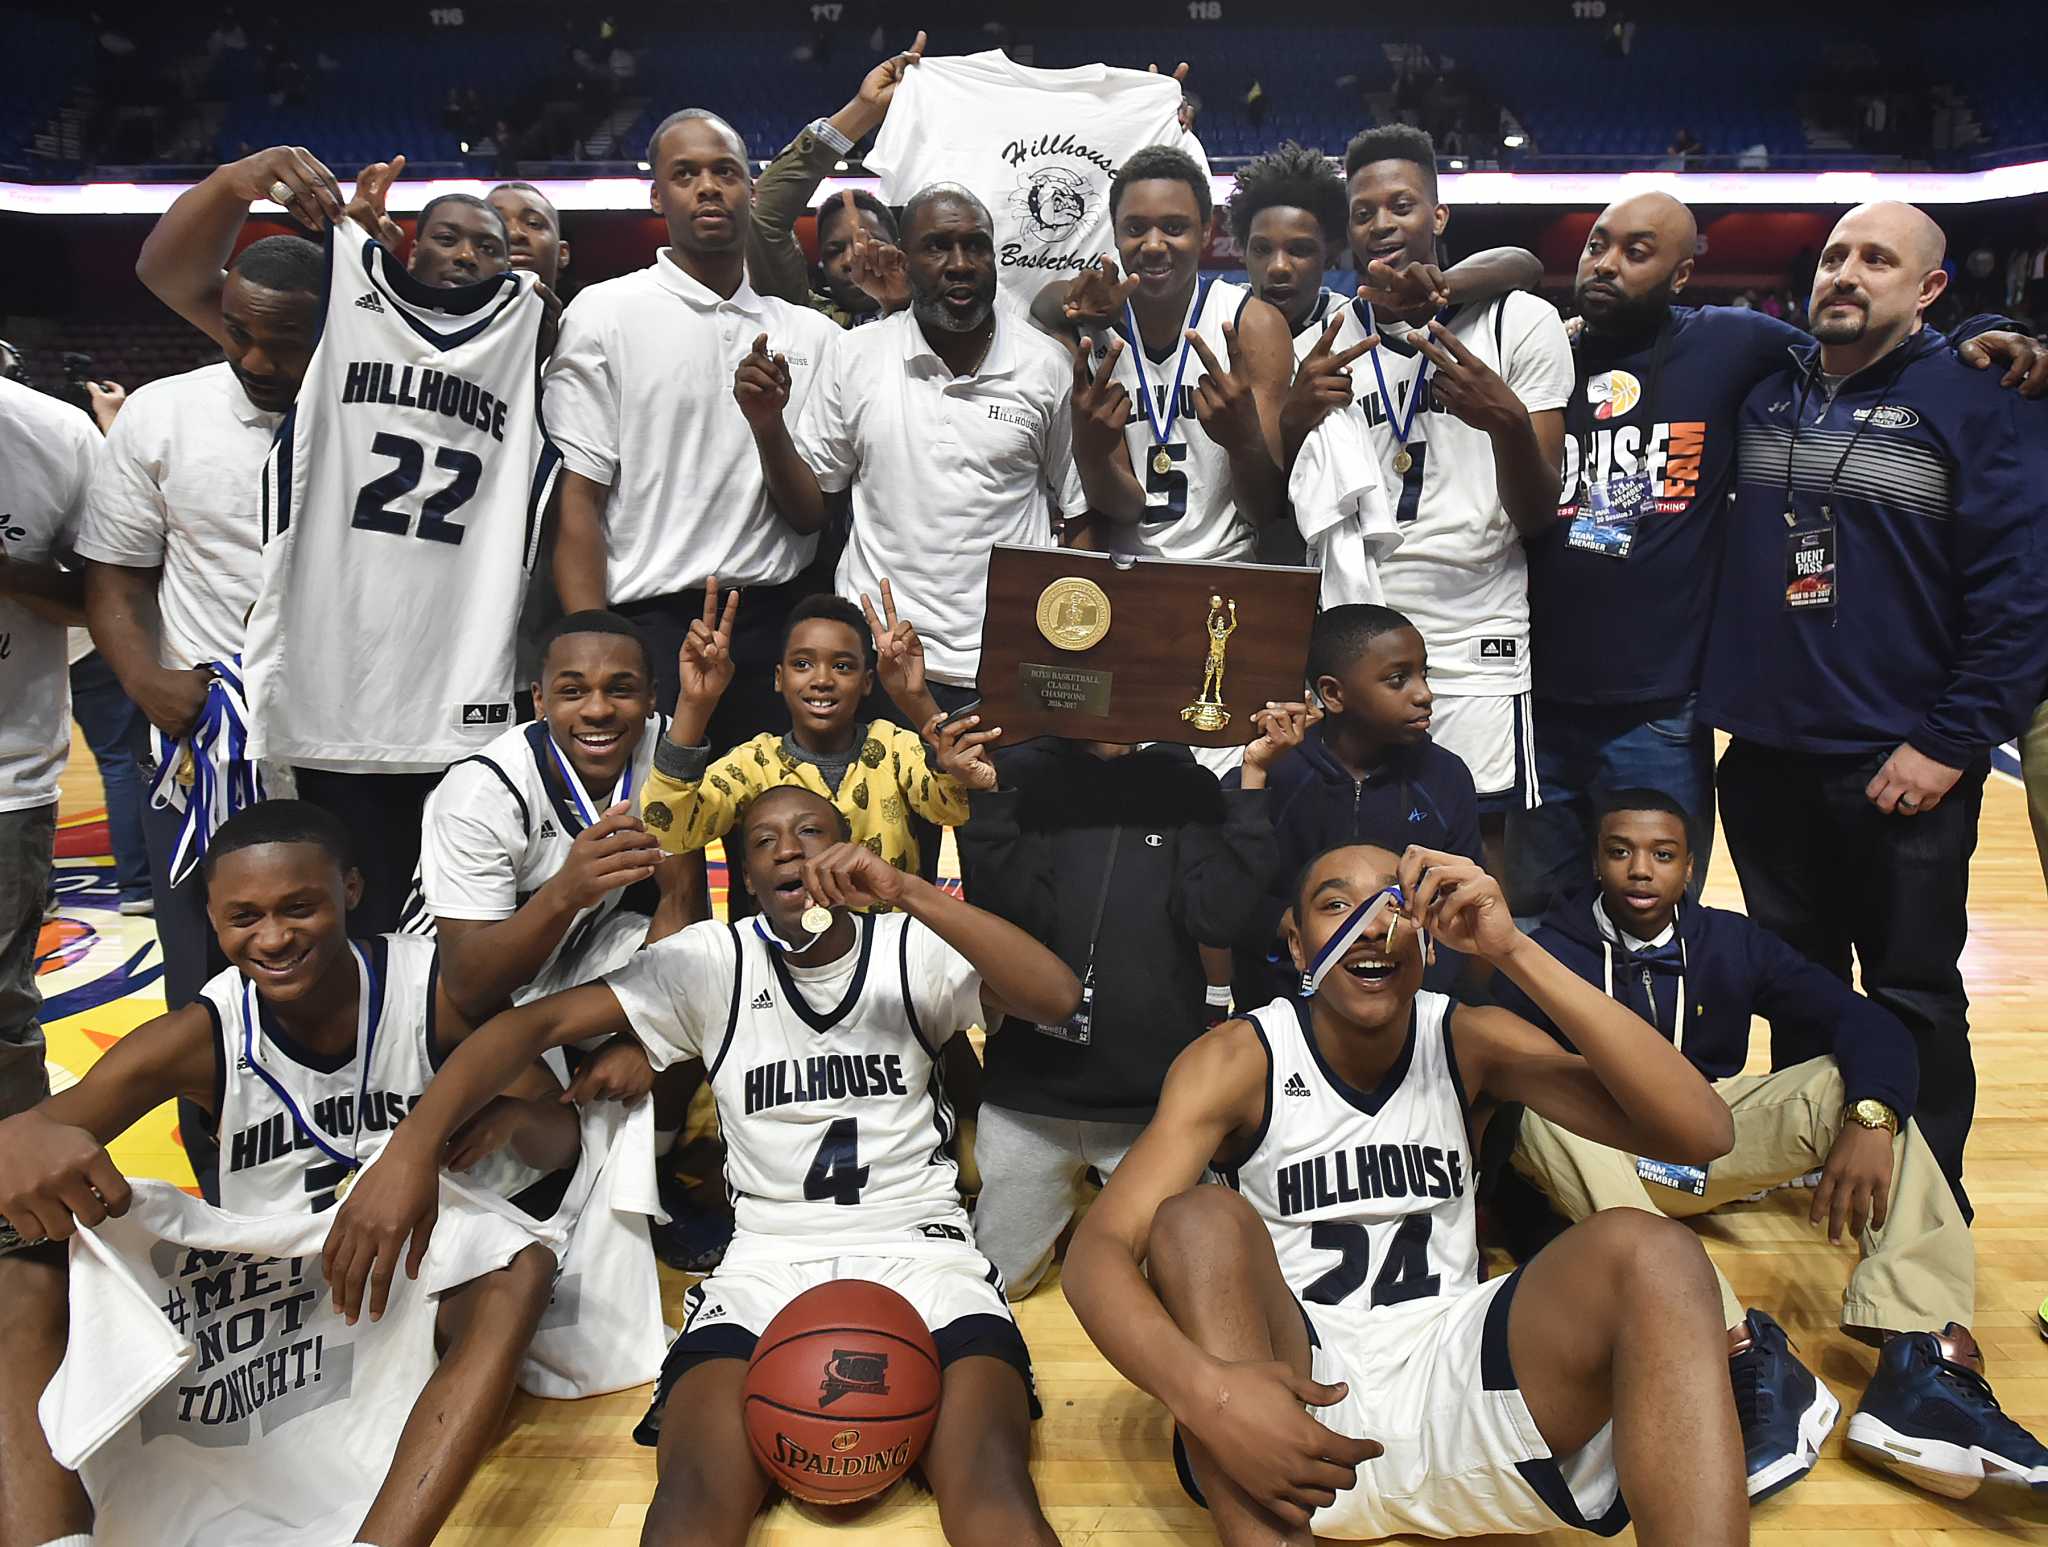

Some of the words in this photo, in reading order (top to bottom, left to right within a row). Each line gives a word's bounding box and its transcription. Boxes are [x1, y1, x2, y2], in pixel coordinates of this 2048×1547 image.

[1188, 1, 1222, 19] 118
[342, 362, 508, 443] HILLHOUSE
[351, 431, 482, 545] 22
[1144, 443, 1188, 524] 5
[1568, 538, 1606, 551] MEMBER
[1795, 548, 1825, 564] EVENT
[1797, 560, 1823, 575] PASS
[745, 1054, 908, 1116] HILLHOUSE
[230, 1091, 423, 1173] HILLHOUS
[803, 1117, 870, 1205] 4
[1640, 1161, 1666, 1176] TEAM
[1277, 1143, 1464, 1217] HILLHOUSE
[1638, 1169, 1680, 1189] MEMBER
[1302, 1212, 1442, 1311] 24
[197, 1290, 316, 1372] NOT
[178, 1335, 324, 1426] TONIGHT!
[773, 1422, 911, 1477] SPALDING
